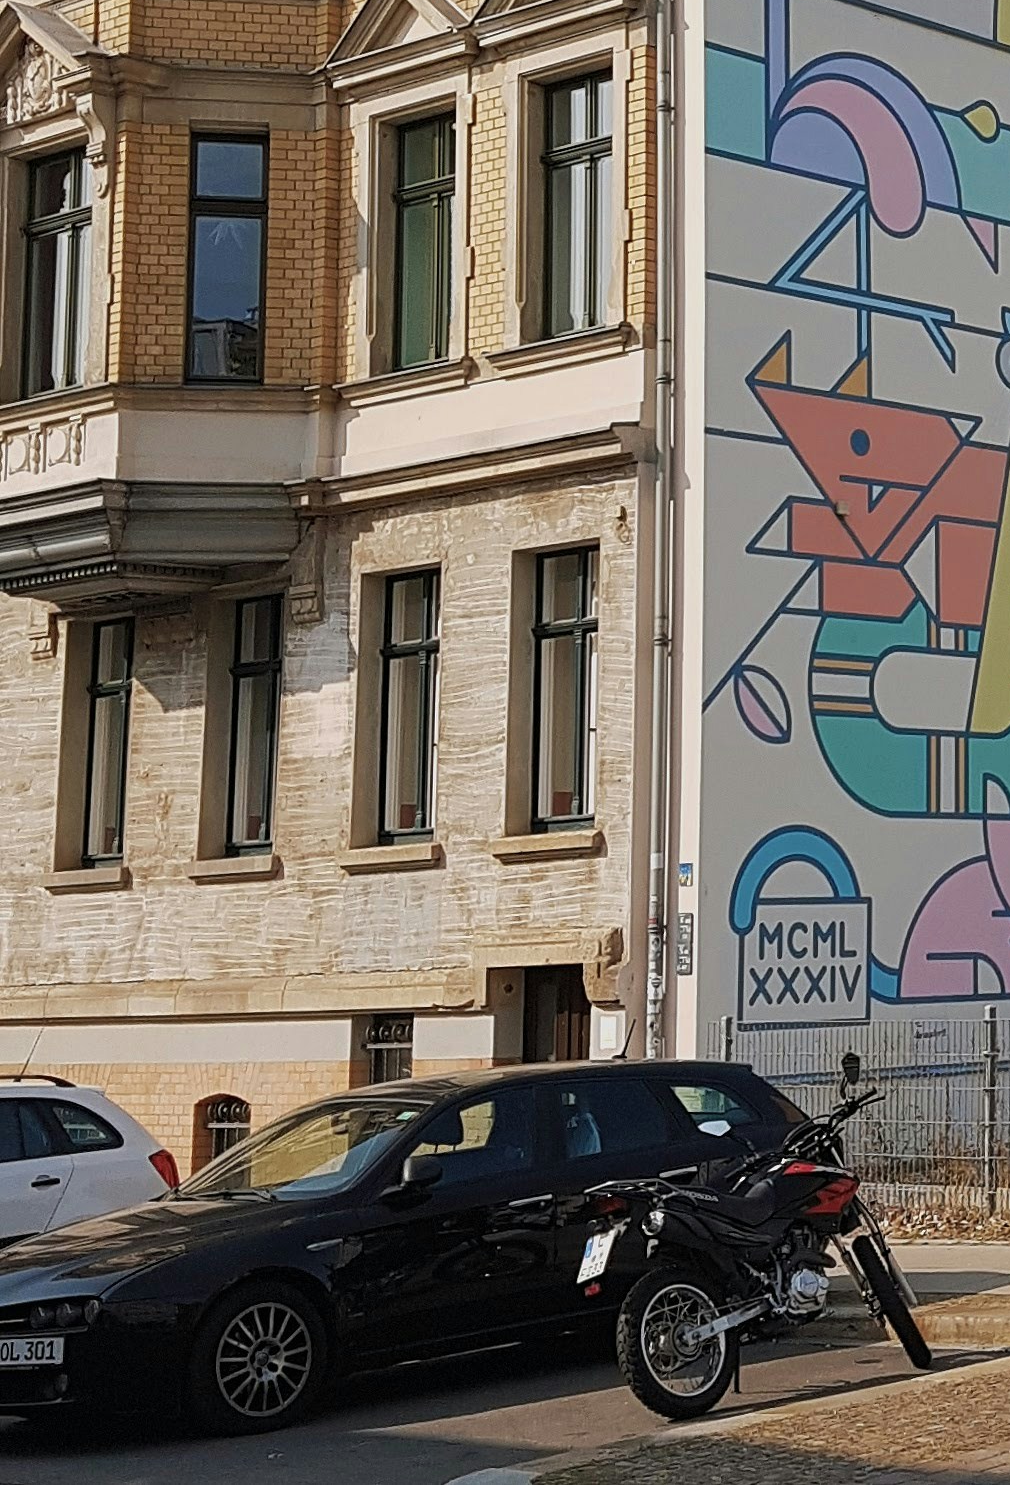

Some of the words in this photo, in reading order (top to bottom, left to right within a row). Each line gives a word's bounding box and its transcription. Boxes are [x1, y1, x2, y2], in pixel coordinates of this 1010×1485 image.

[758, 921, 858, 960] MCML
[749, 965, 862, 1007] XXXIV
[24, 1340, 56, 1361] 301
